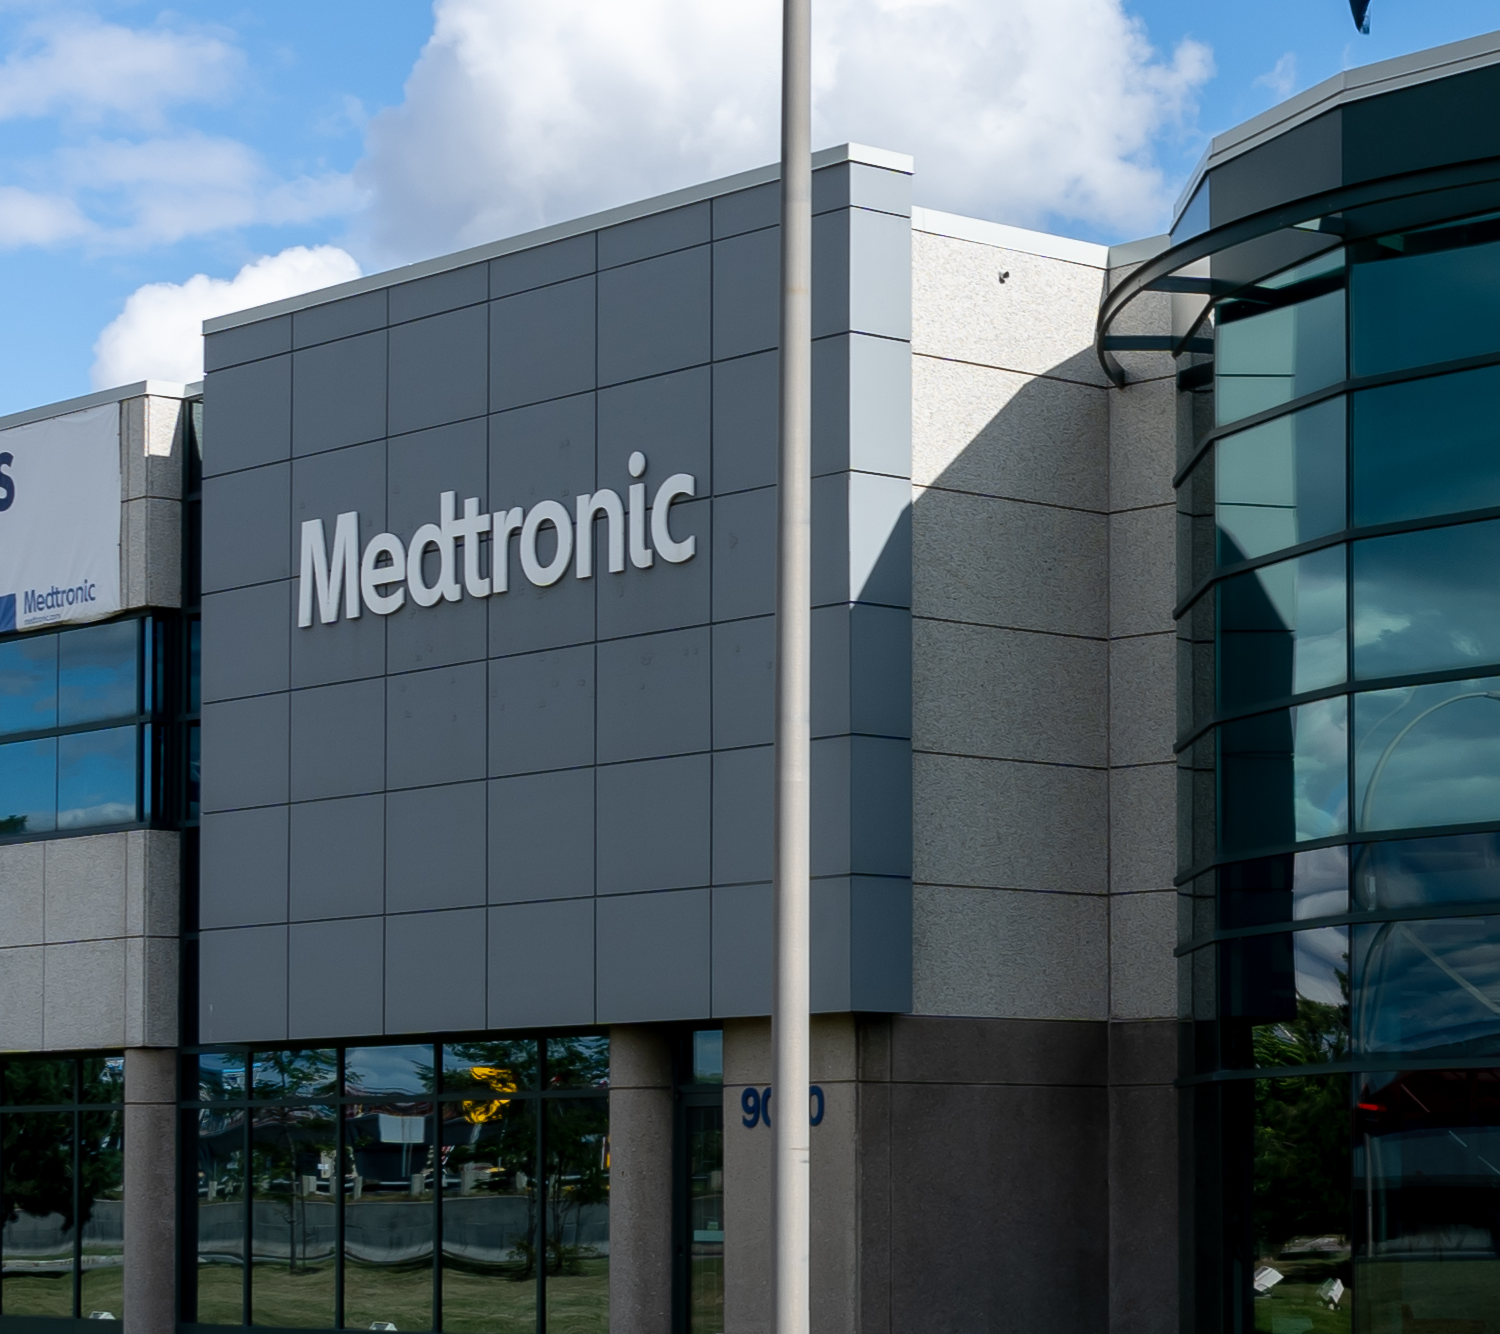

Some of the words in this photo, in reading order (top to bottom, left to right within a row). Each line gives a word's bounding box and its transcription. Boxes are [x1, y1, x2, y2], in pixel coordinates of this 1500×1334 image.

[298, 451, 696, 628] Medtronic
[24, 579, 96, 614] Medtronic
[741, 1085, 825, 1128] 90
